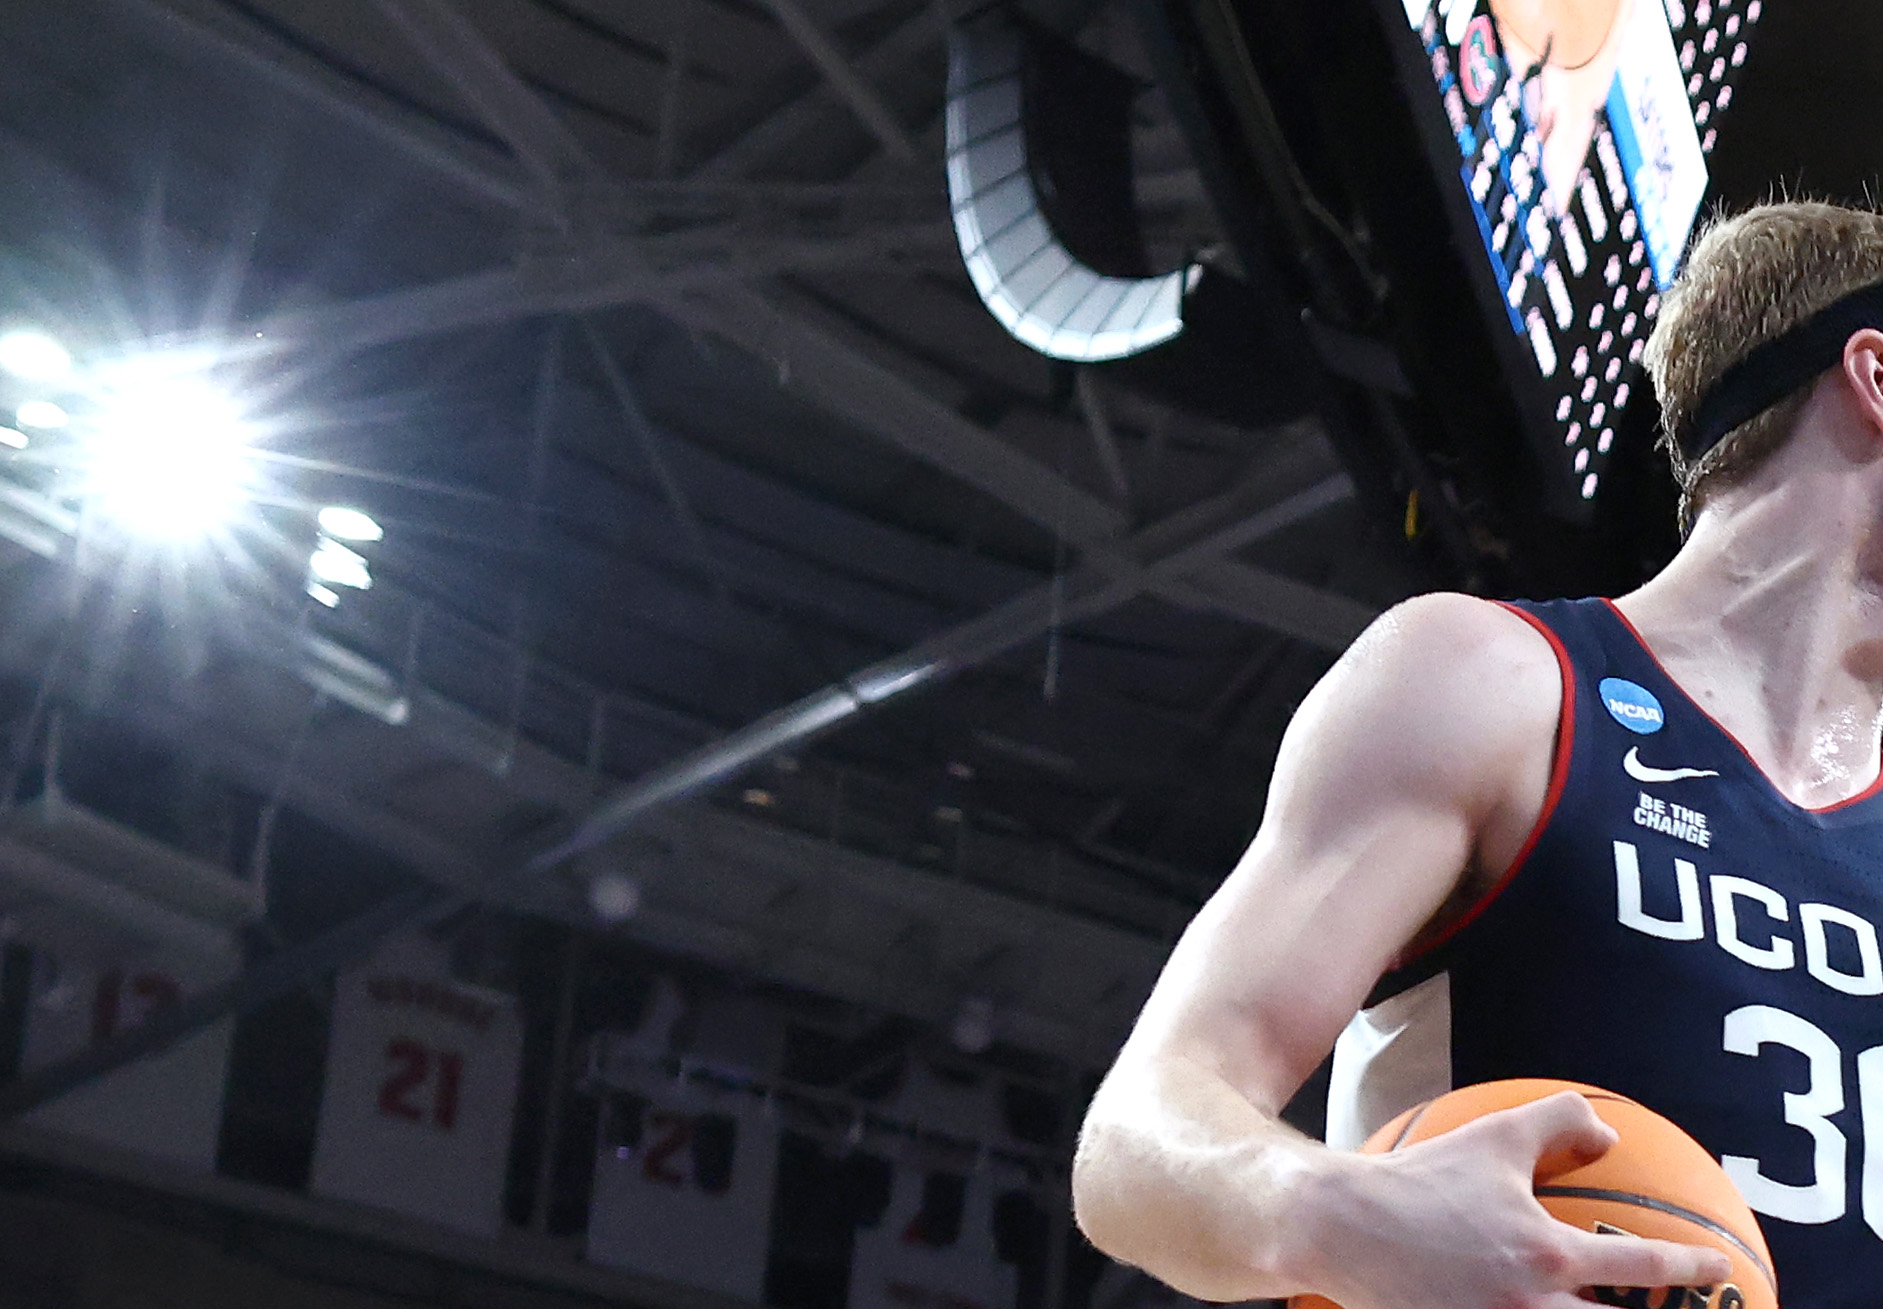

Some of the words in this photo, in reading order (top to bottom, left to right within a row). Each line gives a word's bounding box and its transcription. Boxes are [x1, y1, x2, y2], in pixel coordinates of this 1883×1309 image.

[1609, 699, 1664, 723] NCAA
[1633, 807, 1710, 848] CHANGE
[1639, 791, 1667, 815] BE
[1670, 803, 1707, 829] THE
[377, 1037, 466, 1131] 21
